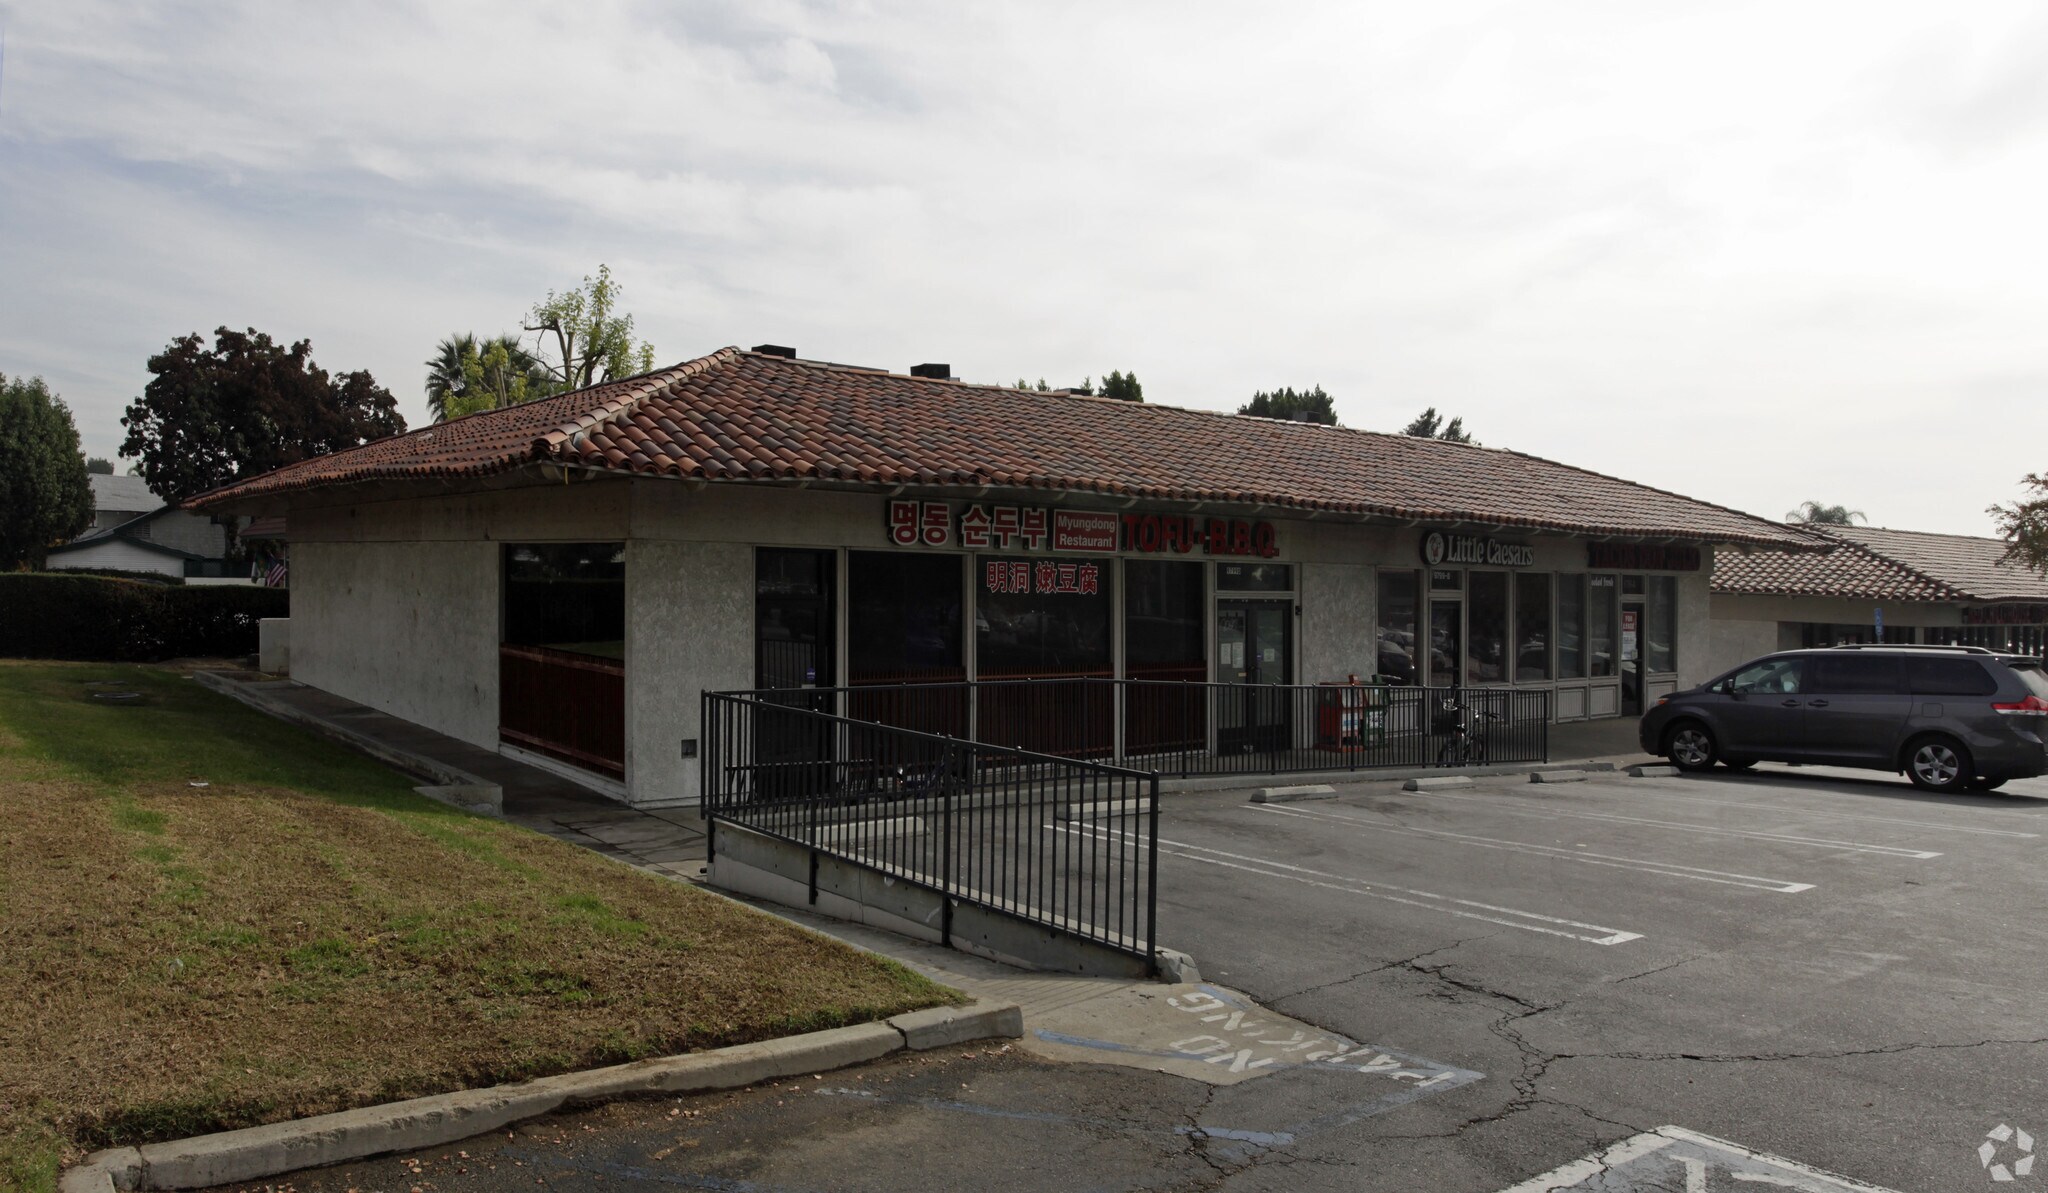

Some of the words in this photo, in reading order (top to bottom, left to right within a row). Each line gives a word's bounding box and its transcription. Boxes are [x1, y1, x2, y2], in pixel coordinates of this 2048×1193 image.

[890, 500, 950, 547] 명동
[961, 504, 1048, 550] 순두부
[1058, 517, 1116, 534] Myungdong
[1059, 533, 1113, 549] Restaurant
[1447, 535, 1484, 563] Little
[1487, 538, 1534, 566] Caesars
[986, 561, 1030, 594] 明洞
[1167, 991, 1456, 1088] PARKING
[1169, 1034, 1274, 1074] NO
